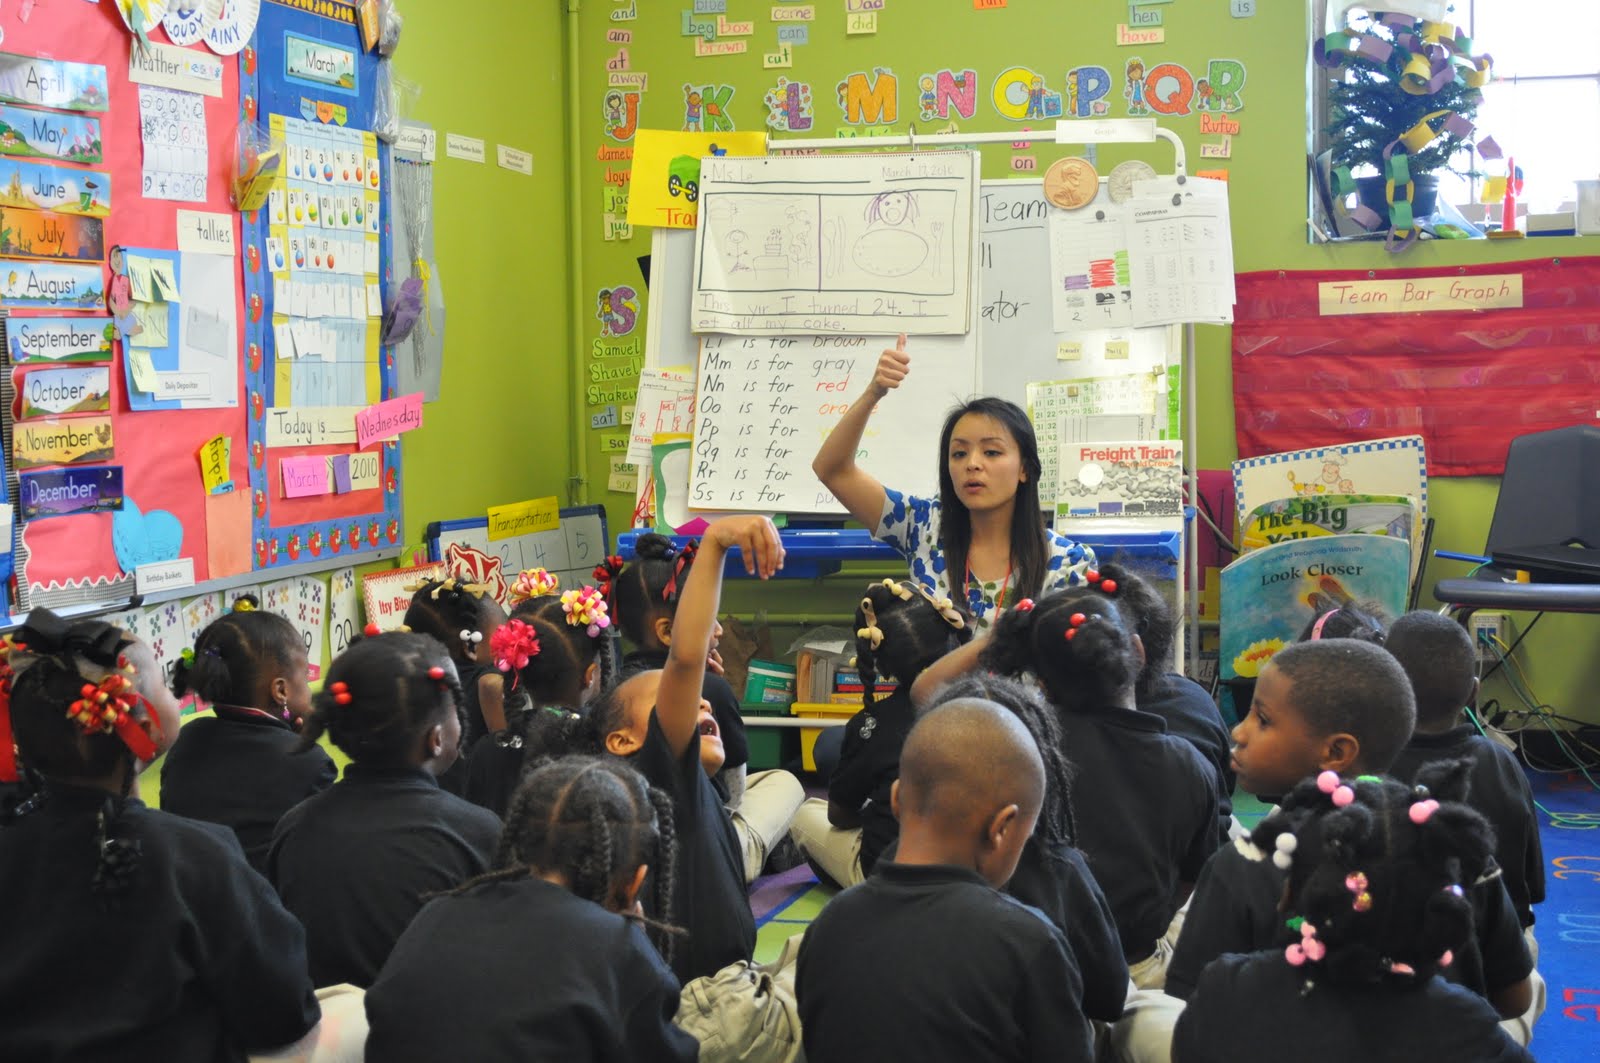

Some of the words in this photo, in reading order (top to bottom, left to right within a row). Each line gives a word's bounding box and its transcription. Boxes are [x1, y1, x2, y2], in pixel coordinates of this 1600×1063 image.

[612, 2, 636, 19] and
[774, 8, 812, 20] come
[1132, 6, 1159, 24] hen
[1237, 2, 1250, 12] is
[689, 16, 714, 40] beg
[720, 17, 750, 34] box
[852, 15, 874, 31] did
[205, 22, 241, 45] AINY
[609, 30, 630, 42] am
[779, 28, 806, 40] can
[1120, 25, 1159, 43] have
[698, 37, 745, 55] brown
[131, 44, 180, 76] Weather
[305, 50, 336, 74] March
[609, 52, 627, 70] at
[767, 48, 790, 65] cut
[26, 66, 66, 96] April
[610, 73, 647, 90] away
[1202, 114, 1238, 134] Rufus
[33, 118, 65, 153] May
[305, 149, 310, 161] 2
[319, 153, 324, 165] 3
[1201, 139, 1229, 156] red
[882, 167, 911, 180] March
[1014, 157, 1034, 170] on
[33, 181, 66, 200] June
[352, 197, 358, 208] 12
[367, 203, 374, 214] 13
[981, 193, 1048, 223] Team
[38, 219, 66, 254] July
[197, 217, 231, 244] tallies
[606, 217, 629, 239] jug
[268, 239, 275, 250] 14
[291, 239, 297, 250] 15
[27, 270, 76, 304] August
[1333, 284, 1388, 305] Team
[1403, 282, 1435, 302] Bar
[1449, 280, 1510, 302] Graph
[700, 293, 731, 312] This
[779, 296, 795, 314] I
[808, 298, 859, 315] turned
[873, 297, 903, 315] 24.
[912, 300, 928, 316] I
[803, 316, 846, 330] cake.
[1072, 311, 1082, 321] 2
[21, 324, 97, 358] September
[704, 352, 732, 371] Mm
[746, 359, 760, 371] is
[768, 353, 793, 371] for
[811, 358, 855, 377] gray
[31, 378, 86, 403] October
[703, 374, 725, 392] Nn
[743, 380, 757, 392] is
[768, 375, 795, 393] for
[816, 375, 850, 392] red
[700, 395, 722, 414] Oo
[738, 402, 753, 414] is
[769, 396, 799, 415] for
[818, 402, 879, 415] orae
[273, 411, 313, 444] Today
[318, 418, 326, 434] is
[359, 407, 421, 441] Wednesday
[592, 408, 615, 426] sat
[26, 425, 94, 452] November
[699, 418, 720, 441] Pp
[738, 423, 754, 436] is
[769, 418, 800, 437] for
[696, 440, 720, 462] Qq
[735, 446, 749, 458] is
[765, 440, 793, 459] for
[1080, 447, 1136, 464] Freight
[1138, 446, 1175, 460] Train
[287, 466, 319, 488] March
[351, 458, 378, 480] 2010
[613, 461, 634, 473] see
[696, 460, 717, 479] Rr
[734, 467, 748, 480] is
[765, 462, 793, 480] for
[30, 475, 97, 504] December
[692, 482, 714, 501] Ss
[729, 489, 744, 502] is
[757, 484, 786, 503] for
[492, 510, 553, 536] Transportation
[1257, 511, 1293, 531] The
[1301, 501, 1348, 531] Big
[502, 543, 514, 569] 2
[535, 542, 545, 563] 4
[576, 532, 588, 560] 5
[1261, 566, 1301, 586] Look
[1307, 563, 1364, 577] Closer
[378, 599, 393, 616] Itsy
[334, 619, 353, 652] 20
